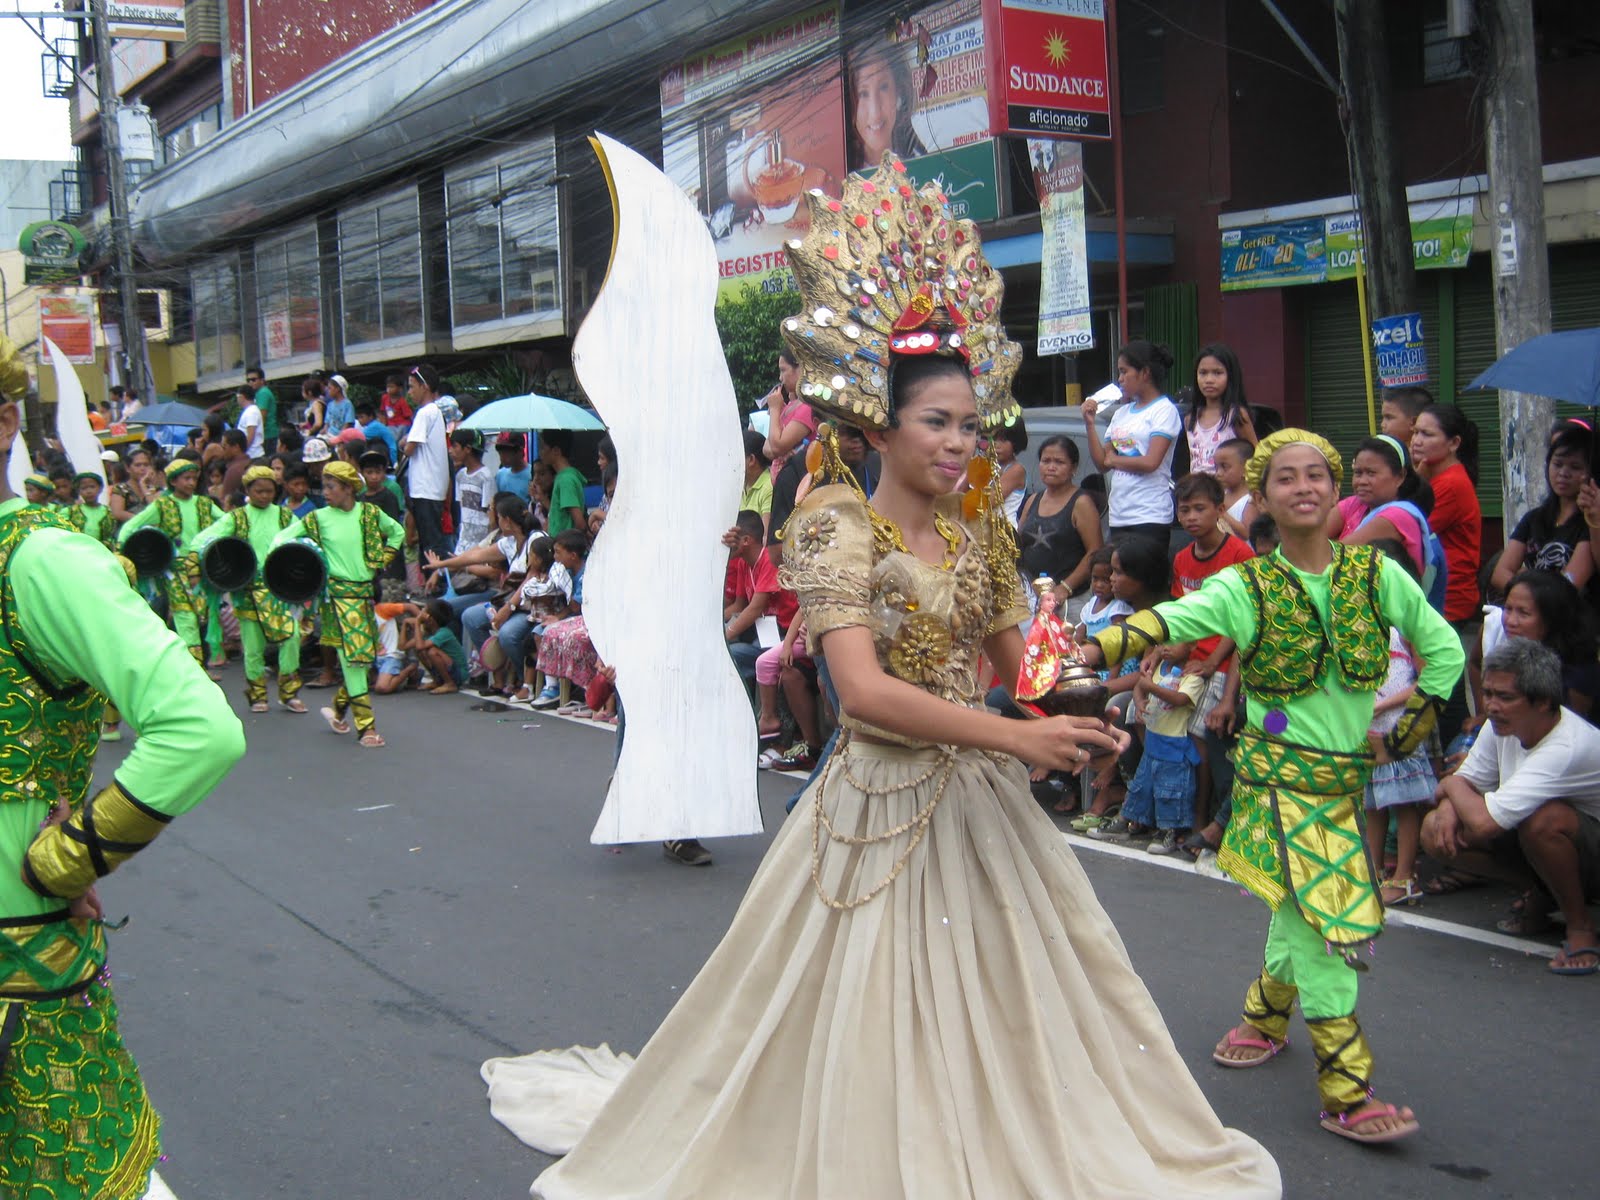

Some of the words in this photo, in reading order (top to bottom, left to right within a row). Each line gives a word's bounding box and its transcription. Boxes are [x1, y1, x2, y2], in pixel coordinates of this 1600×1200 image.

[954, 27, 976, 40] ang
[941, 51, 986, 78] LIFETIM
[917, 68, 987, 102] MBERSHIP
[1010, 65, 1104, 98] SUNDANCE
[1029, 109, 1088, 127] aficionado
[952, 131, 978, 147] INQUIRE
[979, 129, 990, 139] NO
[1057, 164, 1081, 179] FIESTA
[1243, 239, 1257, 249] Get
[1257, 234, 1276, 246] FREE
[718, 250, 793, 277] REGISTR
[1371, 319, 1412, 347] xcel
